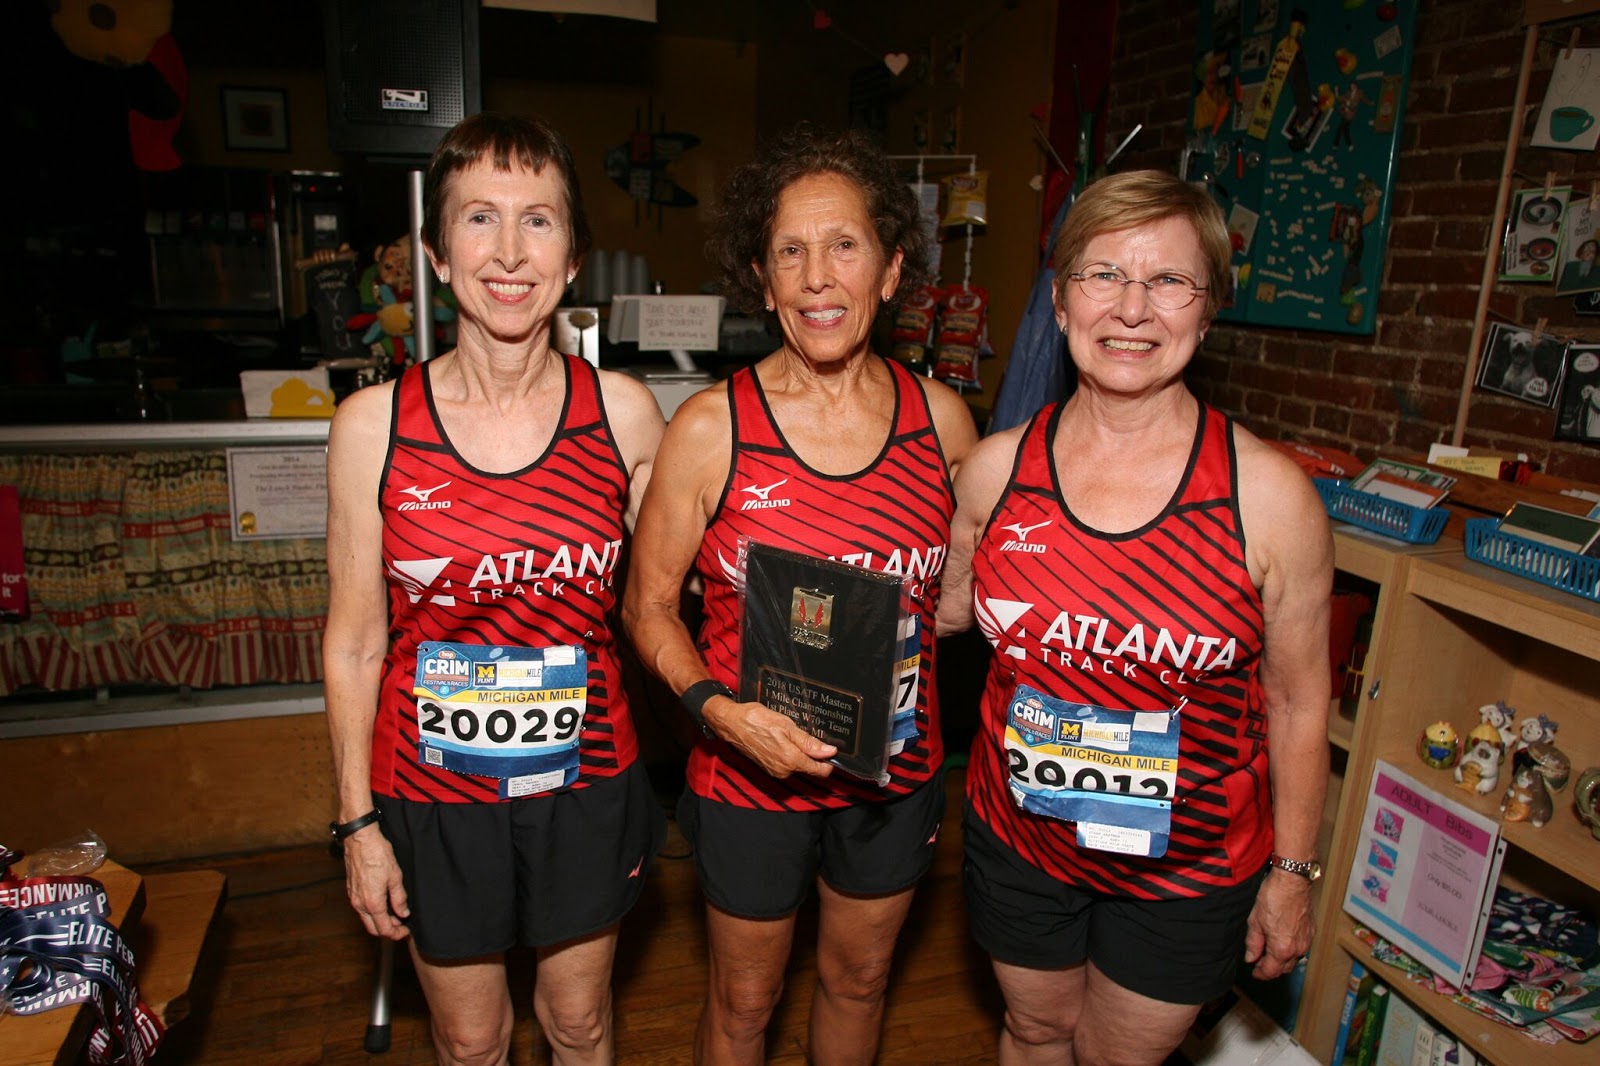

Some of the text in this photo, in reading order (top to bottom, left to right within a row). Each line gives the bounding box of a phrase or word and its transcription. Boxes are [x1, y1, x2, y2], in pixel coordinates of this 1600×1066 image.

[398, 500, 452, 511] MIZUNO
[741, 498, 791, 511] MIZUNO
[1000, 540, 1046, 553] MIZUNO
[469, 539, 622, 588] ATLANT
[826, 543, 946, 581] TLANT
[2, 573, 21, 584] for
[470, 575, 613, 604] TRACK CLU
[3, 587, 12, 598] it
[1040, 611, 1236, 671] ATLANTA
[425, 659, 469, 676] CRIM
[1040, 648, 1208, 685] TRACK CL
[478, 689, 580, 703] MICHIGAN MILE
[767, 677, 853, 711] 2018 USATF Masters
[772, 690, 790, 704] Mile
[792, 697, 853, 724] Championships
[421, 702, 580, 744] 20029
[779, 706, 800, 719] Place
[802, 712, 826, 725] W70+
[828, 720, 850, 735] Team
[1014, 702, 1055, 729] CRIM
[1061, 747, 1170, 771] MICHIGAN MILE
[1391, 785, 1473, 841] ADULT Bibs
[9, 884, 99, 909] ORMANCE
[68, 921, 113, 948] ELITE
